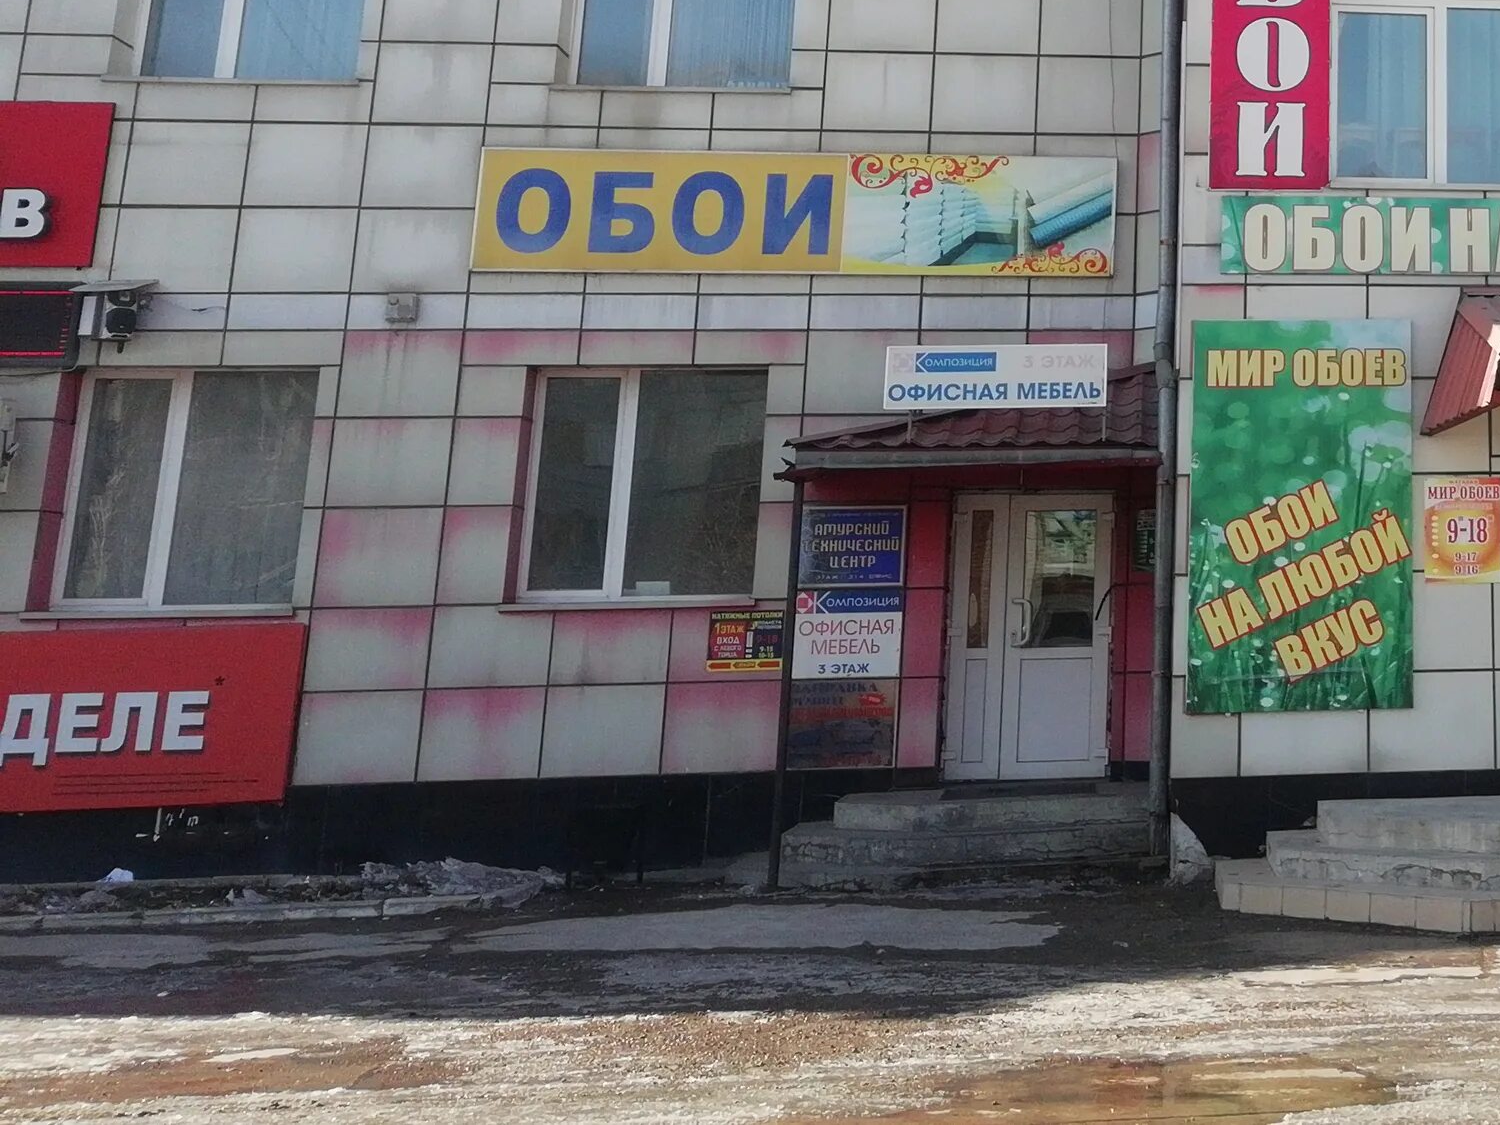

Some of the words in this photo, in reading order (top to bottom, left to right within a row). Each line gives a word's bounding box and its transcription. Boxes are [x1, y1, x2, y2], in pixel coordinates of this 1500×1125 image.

[495, 167, 834, 255] ОБОИ
[1243, 203, 1432, 273] ОБОИ
[1023, 355, 1034, 369] 3
[1041, 354, 1096, 369] ЭТАЖ
[1206, 348, 1286, 388] МИР
[1292, 347, 1407, 388] ОБОЕВ
[888, 383, 1008, 402] ОФИСНАЯ
[1016, 381, 1101, 401] МЕБЕЛЬ
[1428, 486, 1457, 500] МИР
[1460, 486, 1500, 500] ОБОЕВ
[814, 520, 890, 536] АМУРСКИЙ
[1224, 478, 1340, 564] ОБОИ
[805, 536, 900, 552] ТЕХНИЧЕСКИЙ
[829, 556, 876, 569] ЦЕНТР
[1196, 587, 1265, 650] НА
[1258, 507, 1413, 621] ЛЮБОЙ
[799, 619, 894, 636] ОФИСНАЯ
[716, 636, 740, 645] ВХОД
[811, 638, 880, 655] МЕБЕЛЬ
[1273, 598, 1385, 684] ВКУС
[818, 664, 826, 674] 3
[831, 663, 870, 674] ЭТАЖ
